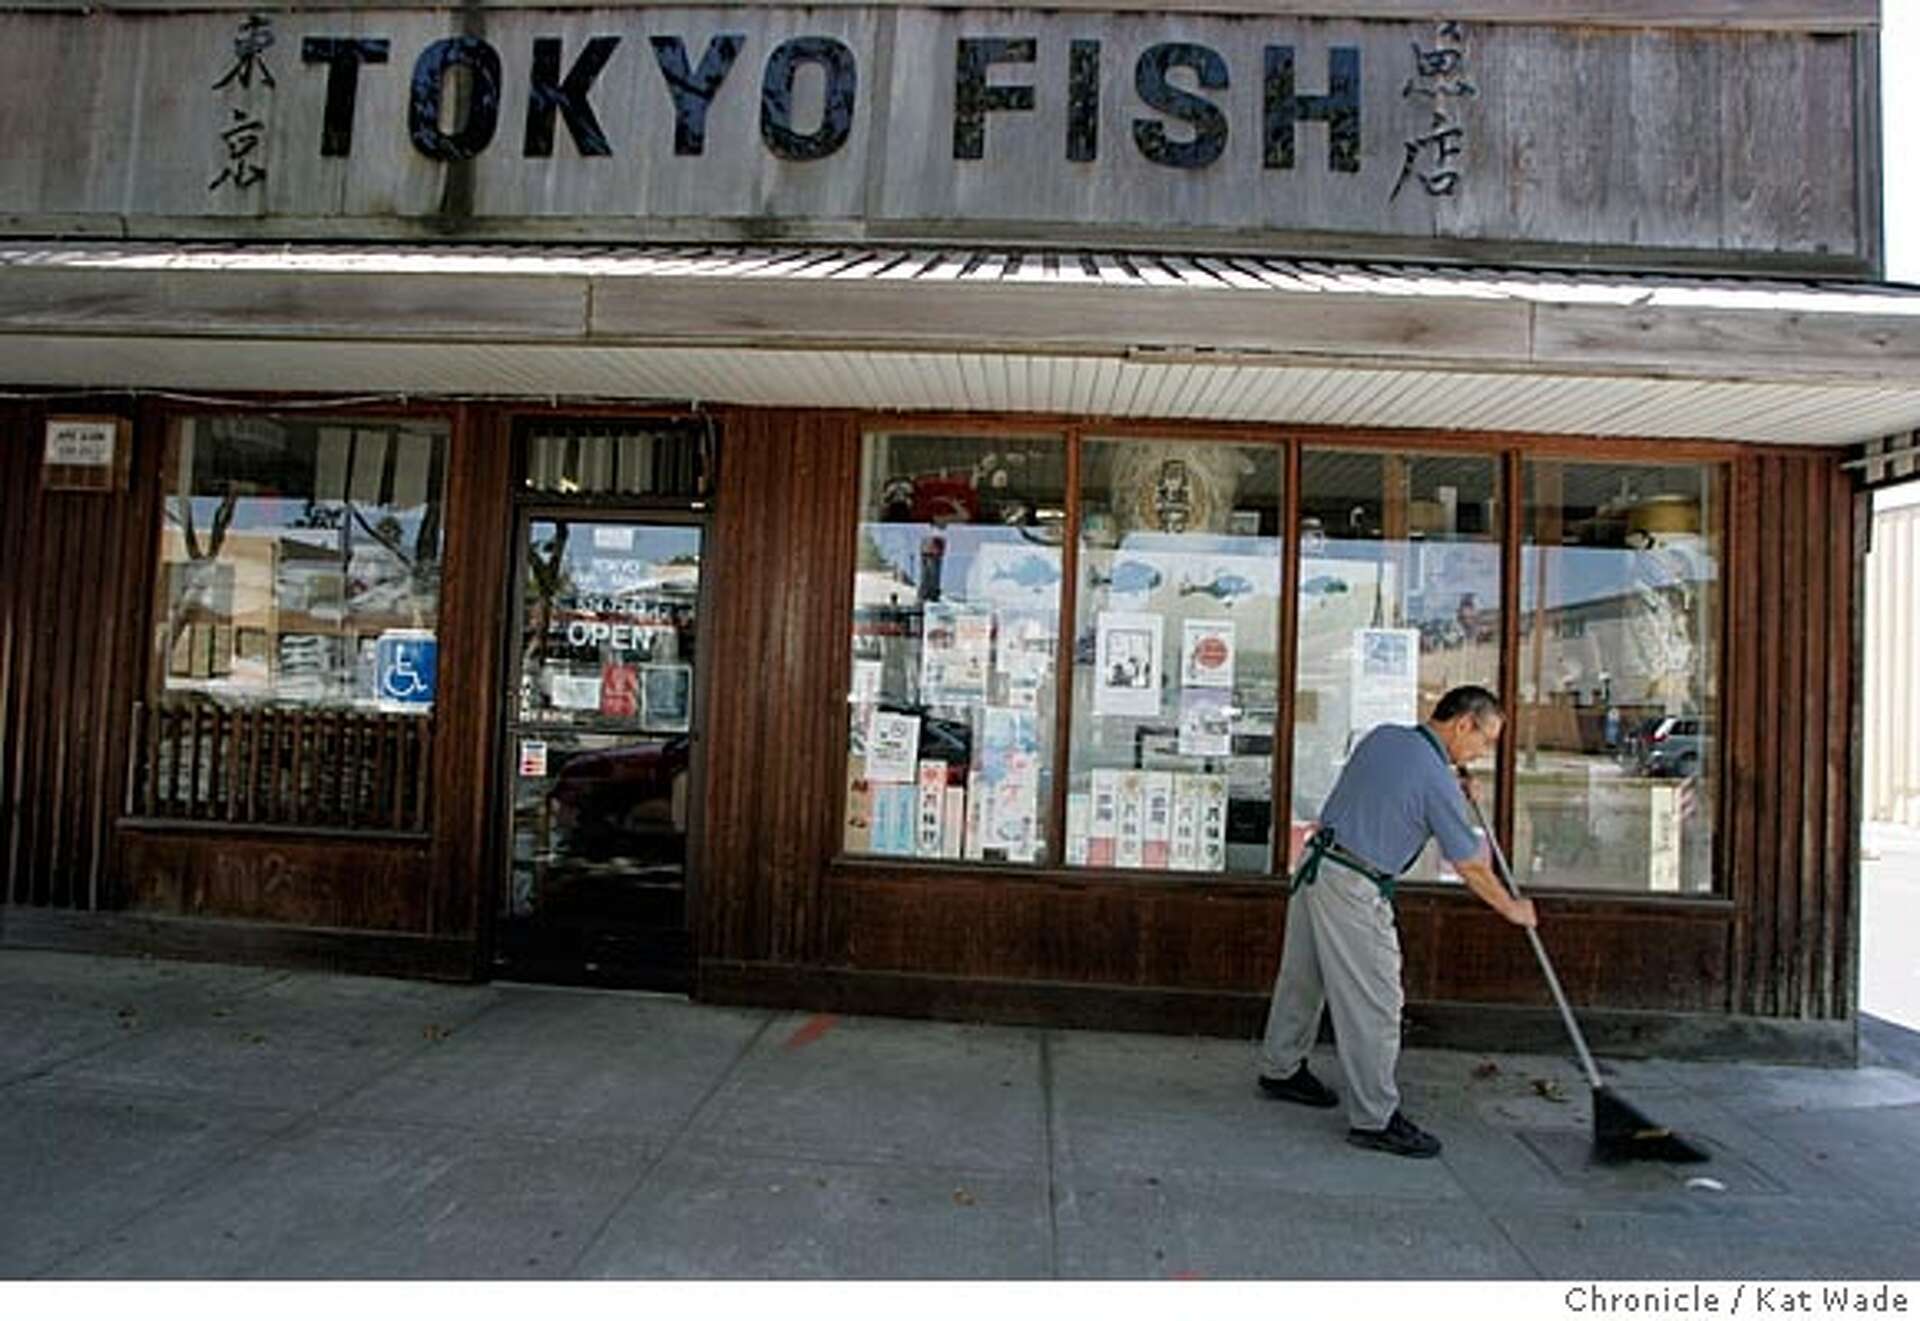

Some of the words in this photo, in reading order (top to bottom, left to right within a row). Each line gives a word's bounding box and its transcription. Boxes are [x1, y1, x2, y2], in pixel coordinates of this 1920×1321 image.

[302, 35, 857, 161] TOKYO
[953, 36, 1362, 173] FISH
[567, 622, 655, 649] OPEN
